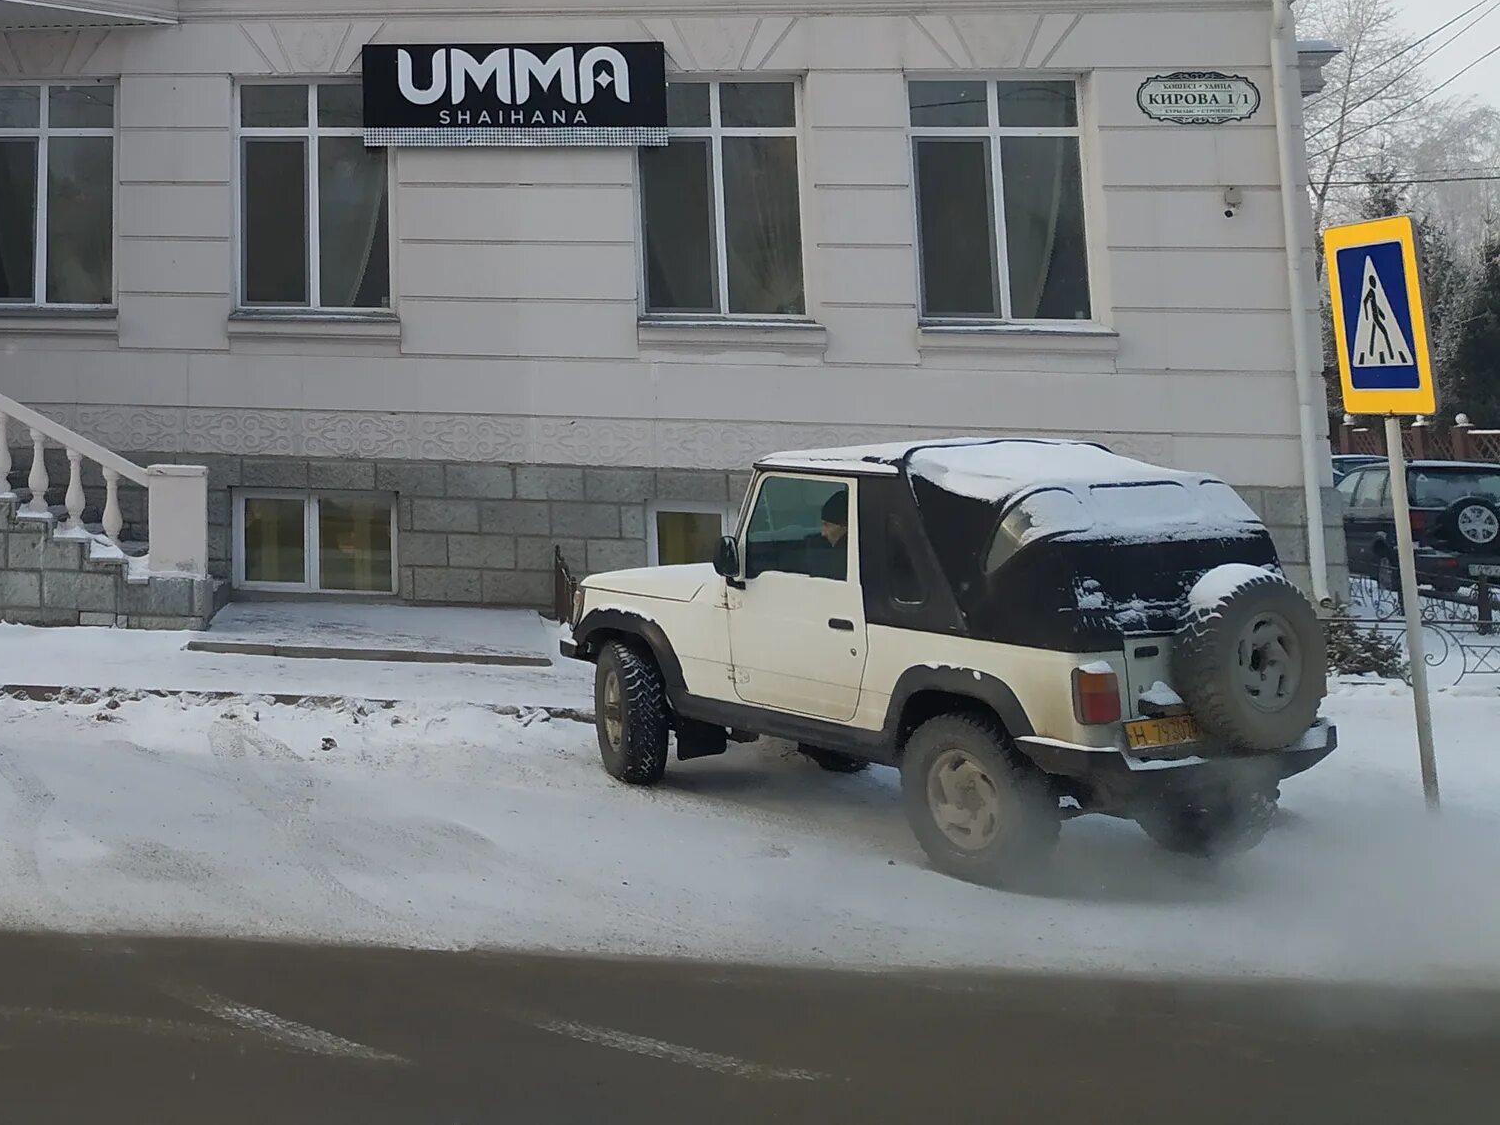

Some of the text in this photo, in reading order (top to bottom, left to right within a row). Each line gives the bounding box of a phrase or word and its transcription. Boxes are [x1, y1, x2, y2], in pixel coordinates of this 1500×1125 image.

[397, 45, 630, 105] UMMA
[1148, 93, 1249, 105] КИРОВА 1/1
[438, 109, 588, 124] SHAIHANA
